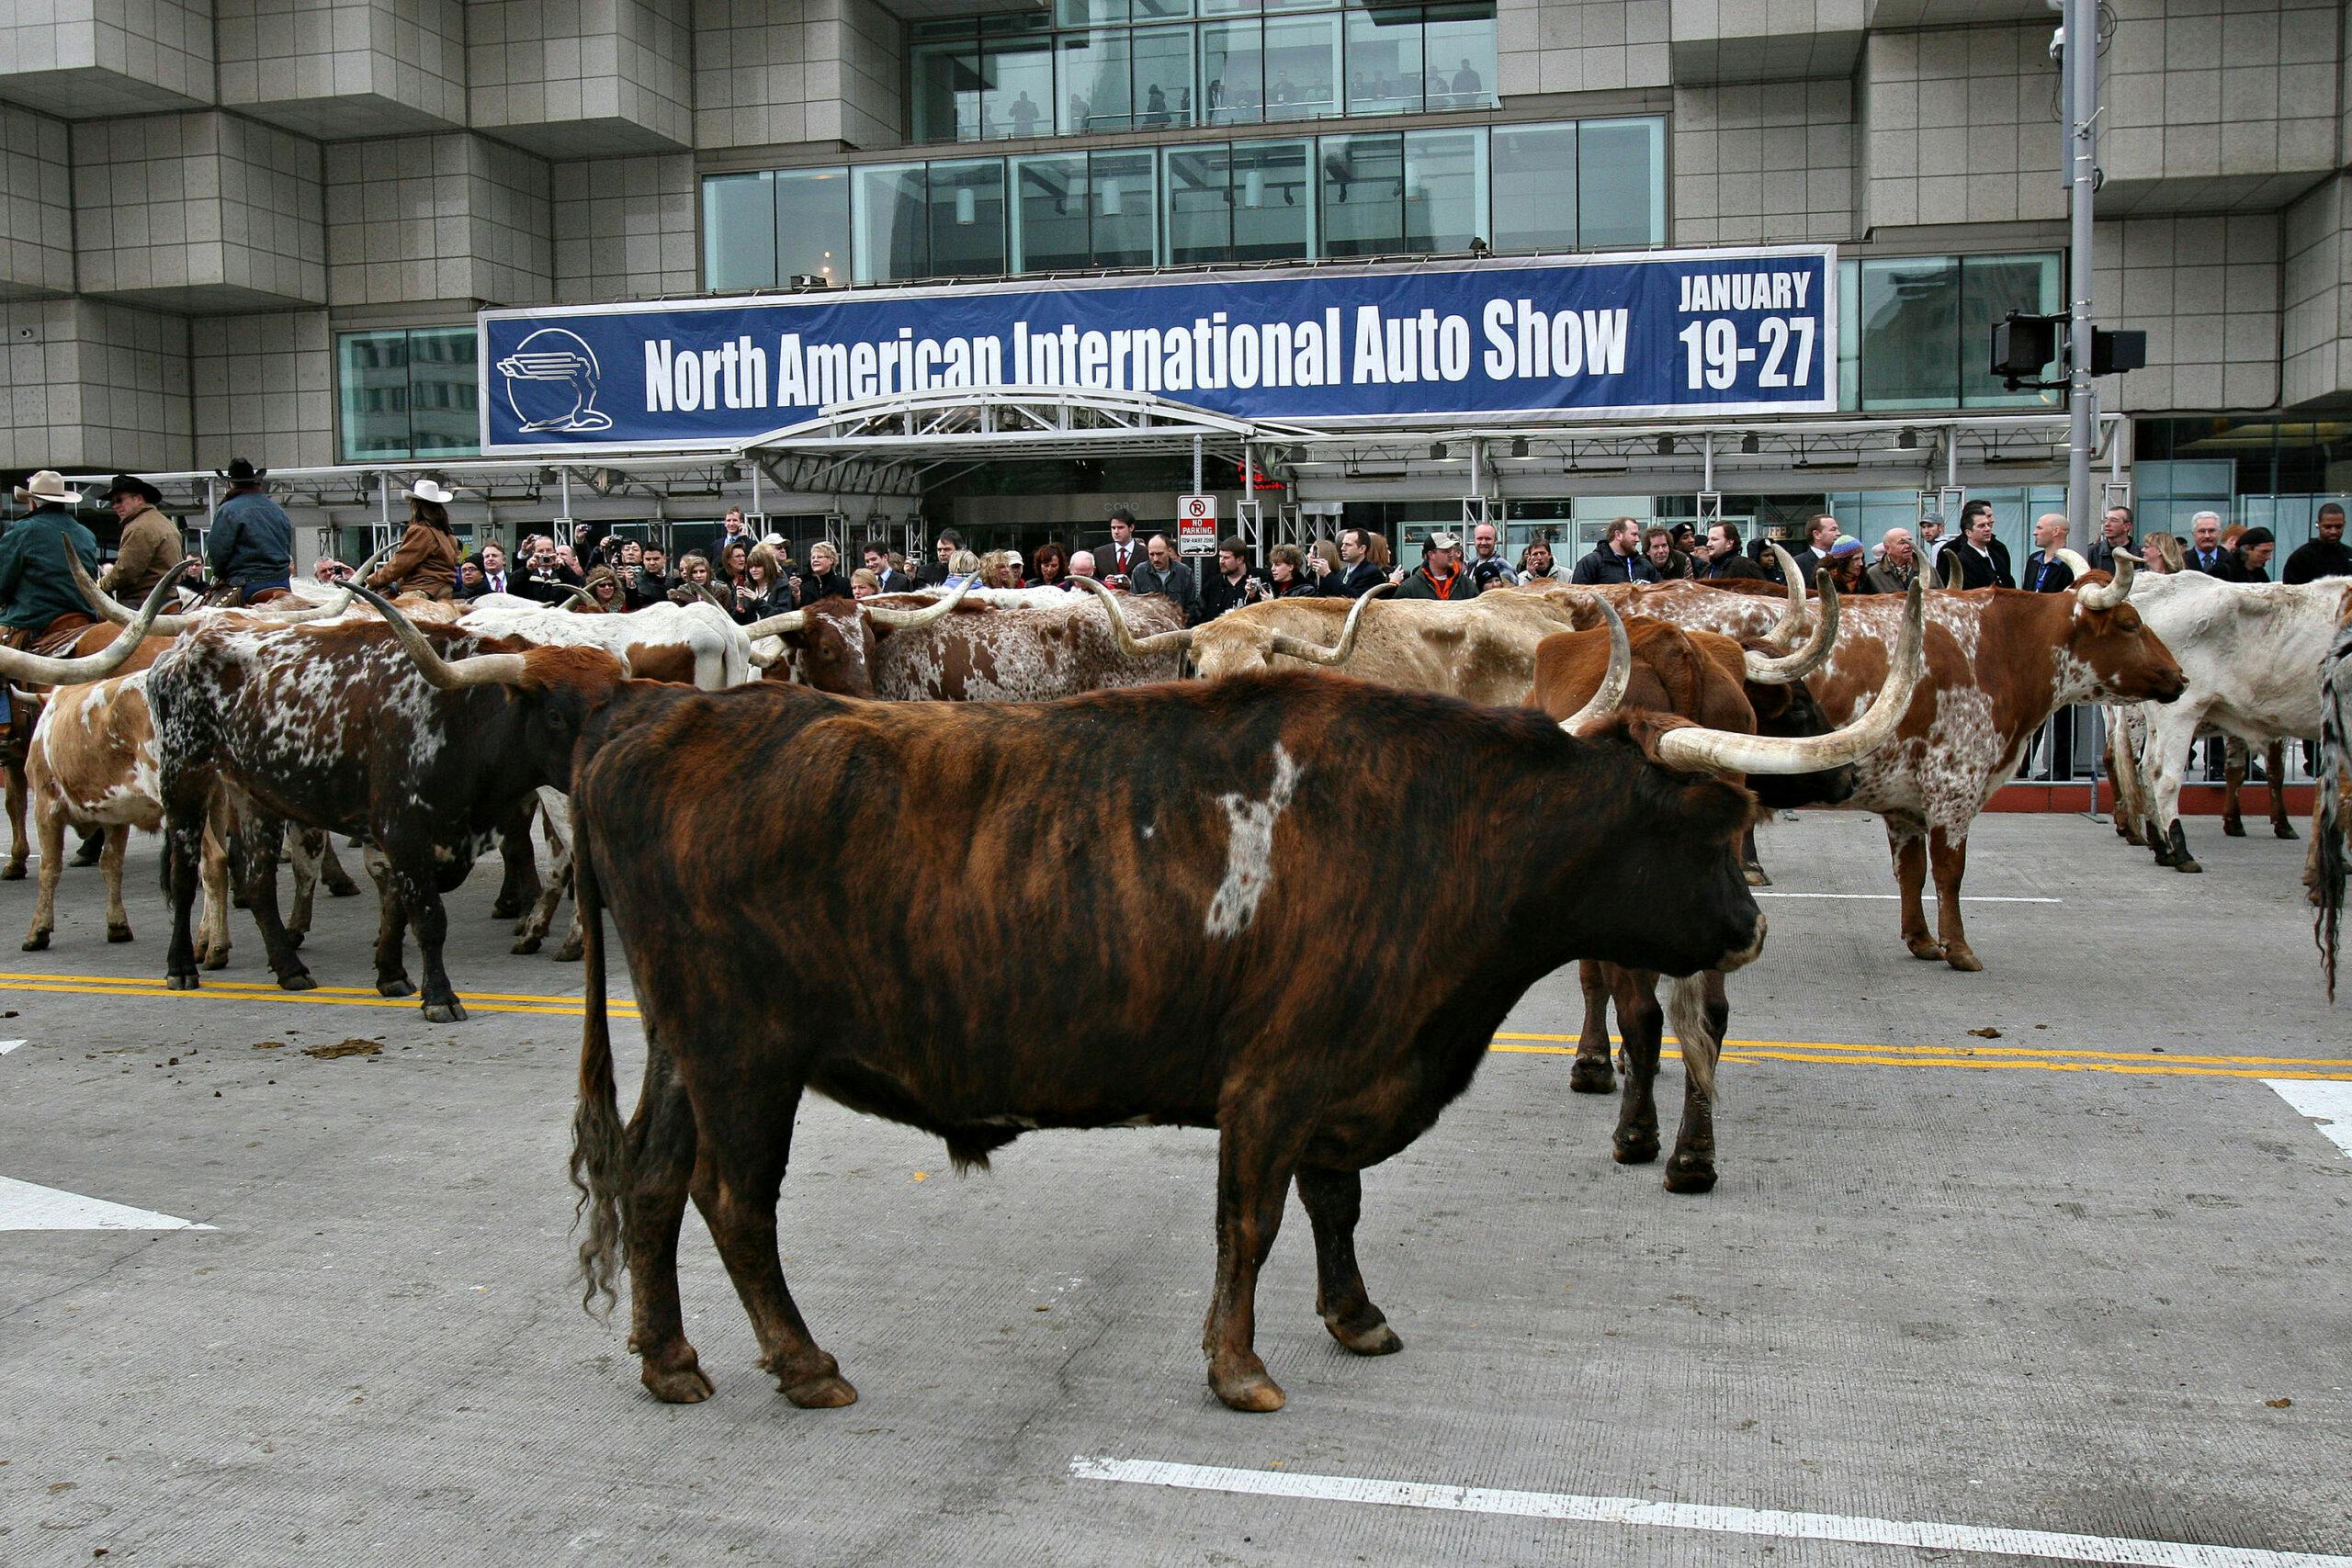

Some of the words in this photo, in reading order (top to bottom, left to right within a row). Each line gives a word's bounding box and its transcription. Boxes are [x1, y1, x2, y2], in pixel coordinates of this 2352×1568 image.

[1679, 271, 1812, 312] JANUARY
[644, 335, 767, 412] North
[776, 326, 1003, 407] American
[1013, 306, 1341, 392] International
[1352, 305, 1470, 384] Auto
[1483, 298, 1629, 381] Show
[1679, 316, 1815, 390] 19-27
[1182, 526, 1213, 535] PARKING
